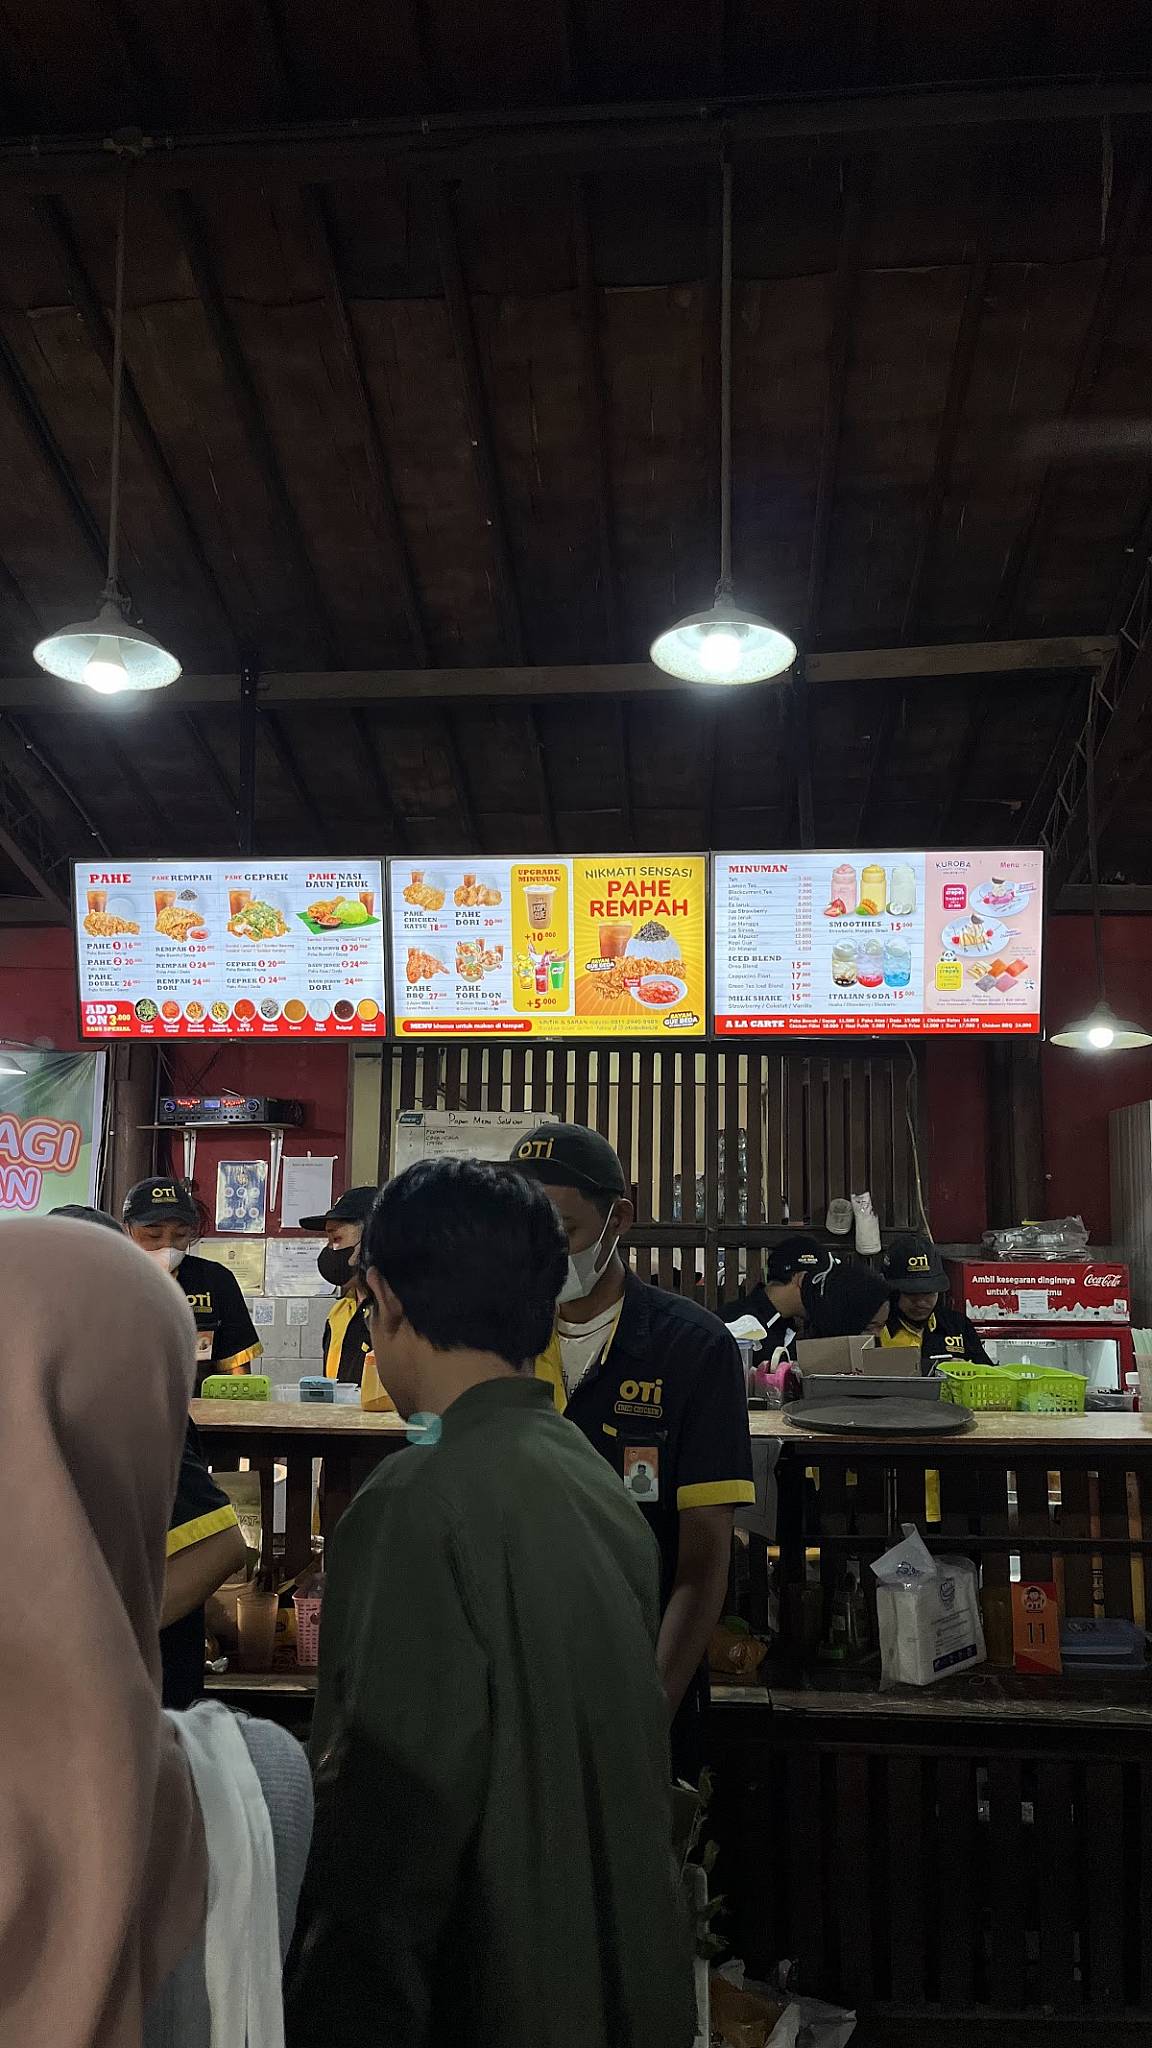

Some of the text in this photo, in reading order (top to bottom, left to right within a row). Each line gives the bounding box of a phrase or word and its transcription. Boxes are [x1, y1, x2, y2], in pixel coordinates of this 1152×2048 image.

[585, 866, 692, 879] NIKMATI SENSASI
[729, 865, 788, 873] MINUMAN
[89, 874, 131, 883] PAHE
[244, 873, 288, 881] GEPREK
[336, 881, 368, 889] JERUK
[608, 880, 672, 897] PAHE
[590, 899, 688, 917] REMPAH
[86, 1004, 118, 1015] ADD
[86, 1015, 107, 1025] ON
[726, 1020, 785, 1028] A LA CARTE
[972, 1275, 1076, 1286] Ambil kesegaran dinginnya
[986, 1287, 1009, 1296] untuk
[1026, 1622, 1046, 1644] 11
